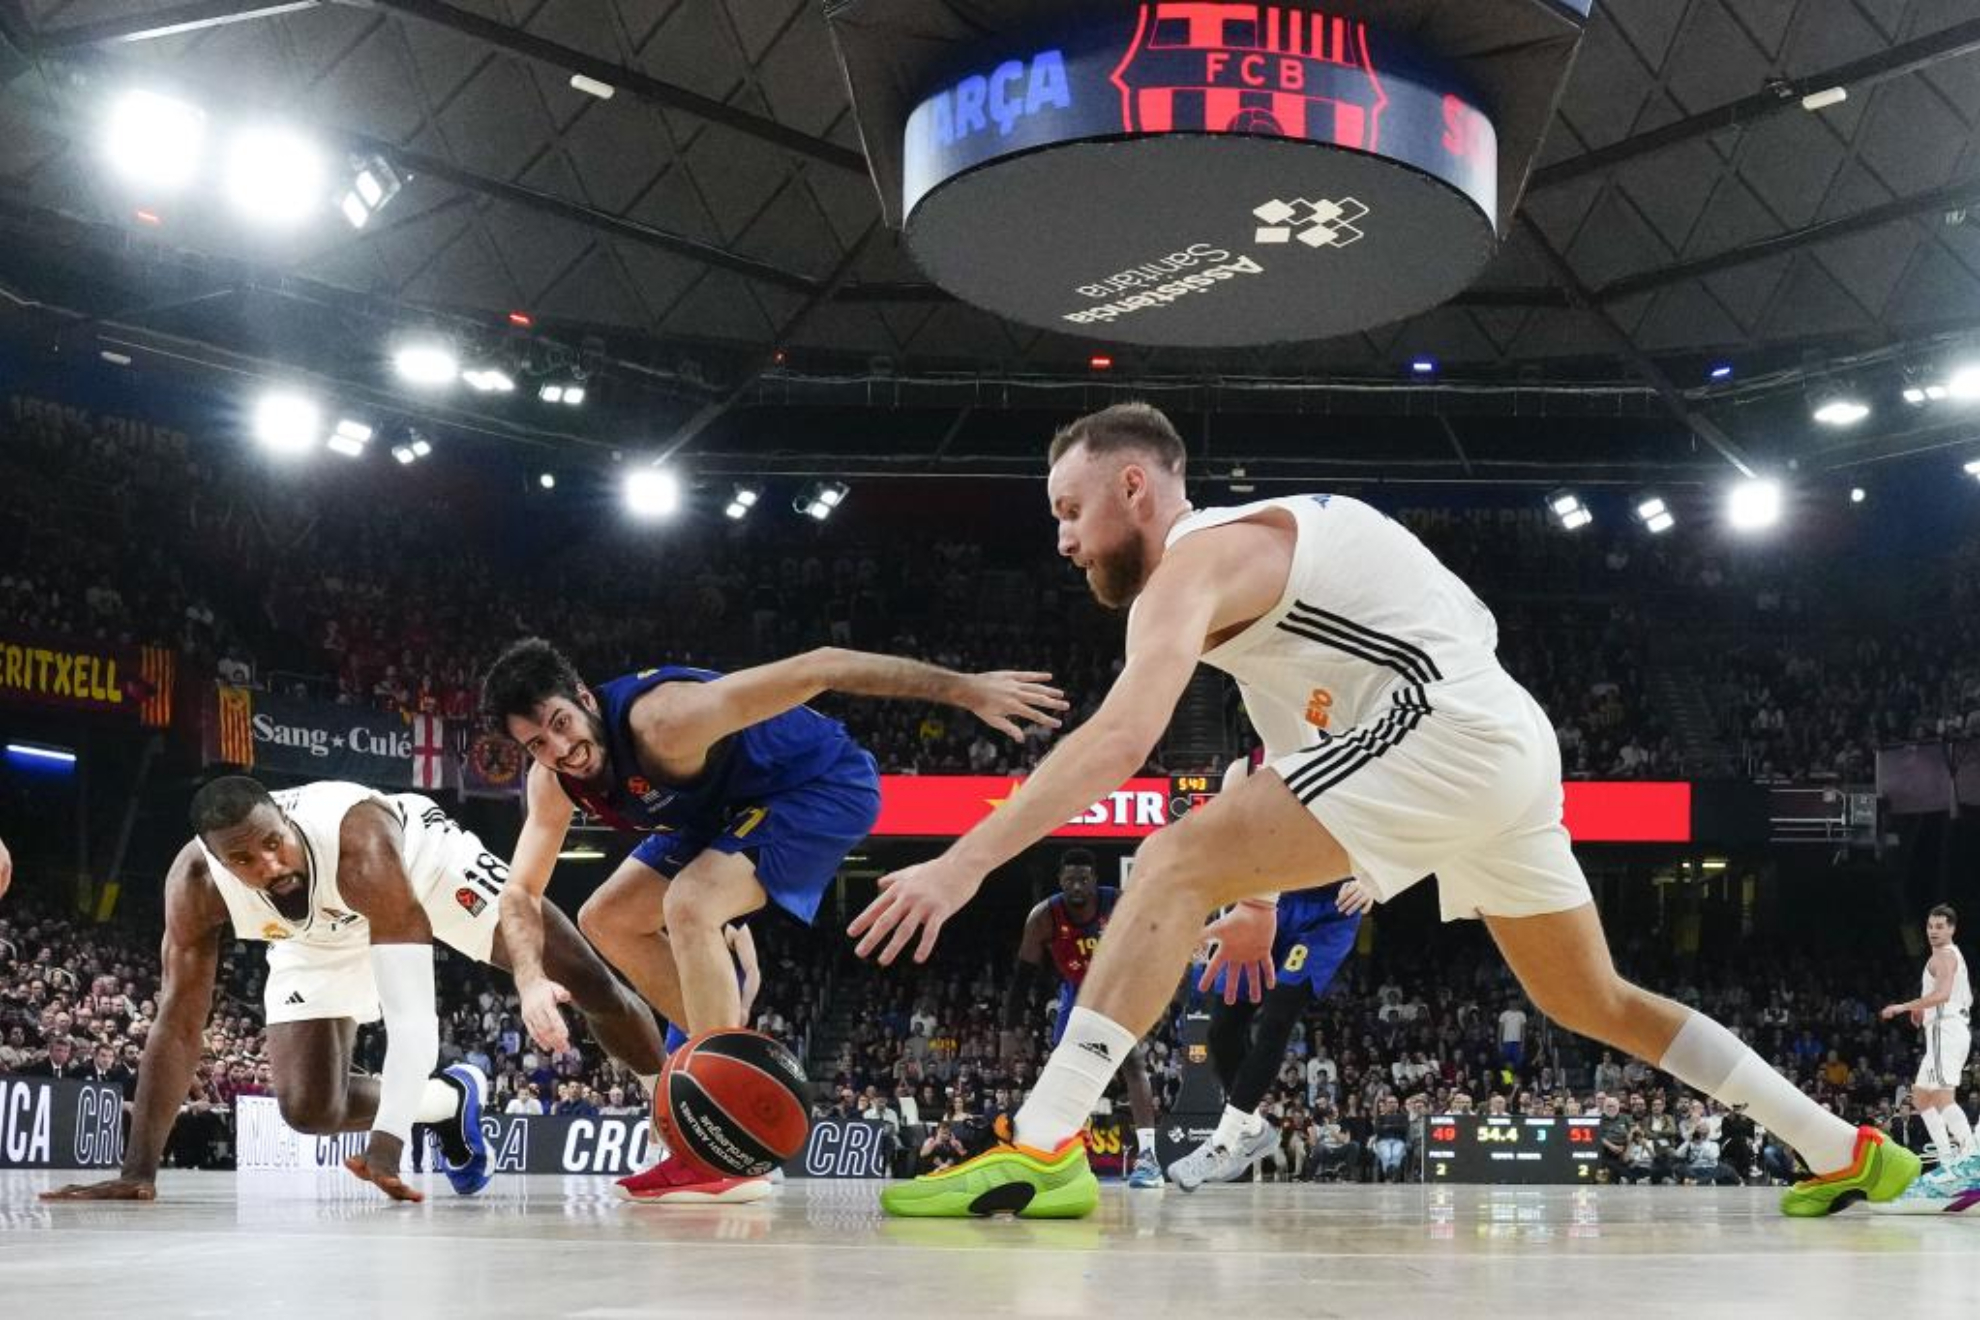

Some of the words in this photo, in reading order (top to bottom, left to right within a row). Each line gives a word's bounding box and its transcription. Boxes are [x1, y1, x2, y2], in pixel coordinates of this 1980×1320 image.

[1075, 243, 1231, 298] Sanitària
[252, 713, 329, 757] Sang
[349, 726, 413, 759] Culé
[1066, 790, 1166, 825] STR
[463, 852, 510, 896] 18
[1285, 944, 1308, 972] 8
[1477, 1126, 1519, 1142] 54.4
[1569, 1128, 1593, 1142] 51
[1436, 1163, 1447, 1176] 2
[1577, 1164, 1589, 1176] 2
